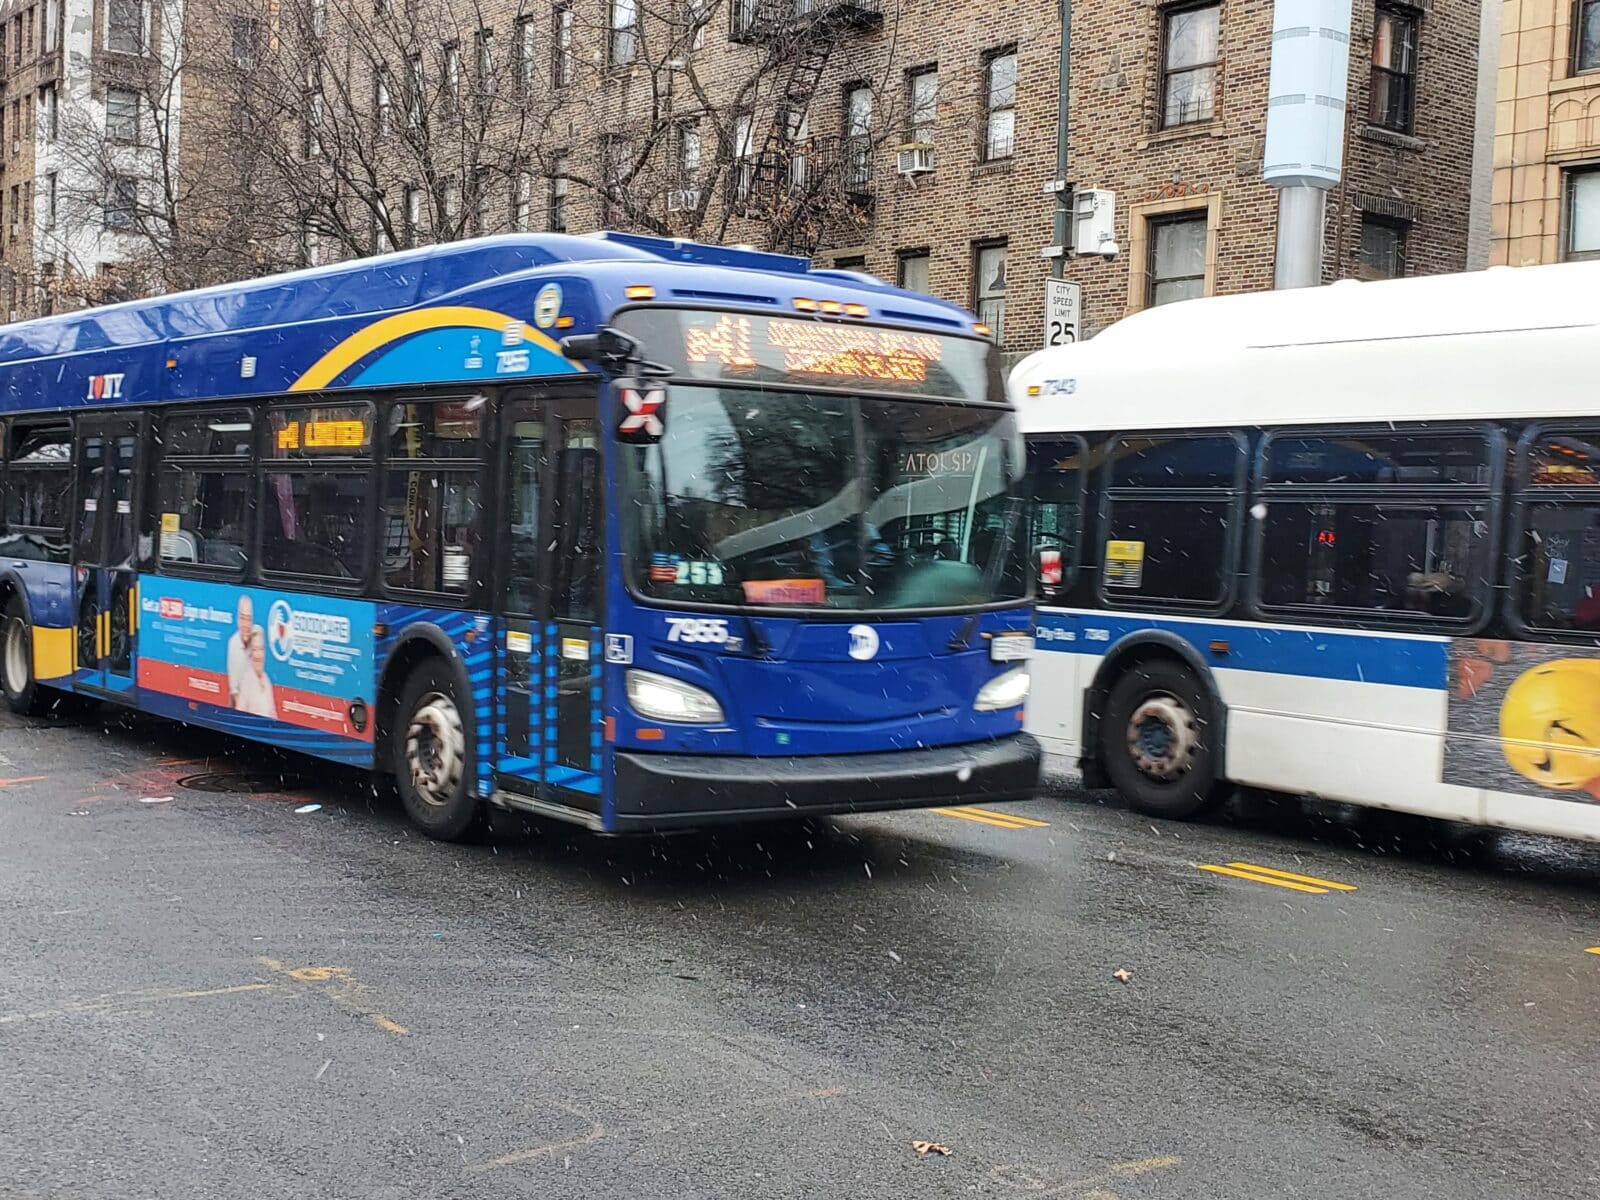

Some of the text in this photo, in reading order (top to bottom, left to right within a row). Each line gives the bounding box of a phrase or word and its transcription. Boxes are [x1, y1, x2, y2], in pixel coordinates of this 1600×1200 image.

[1055, 285, 1071, 295] CITY
[1053, 296, 1073, 307] SPEED
[1054, 308, 1071, 318] LIMIT
[1050, 320, 1075, 346] 25
